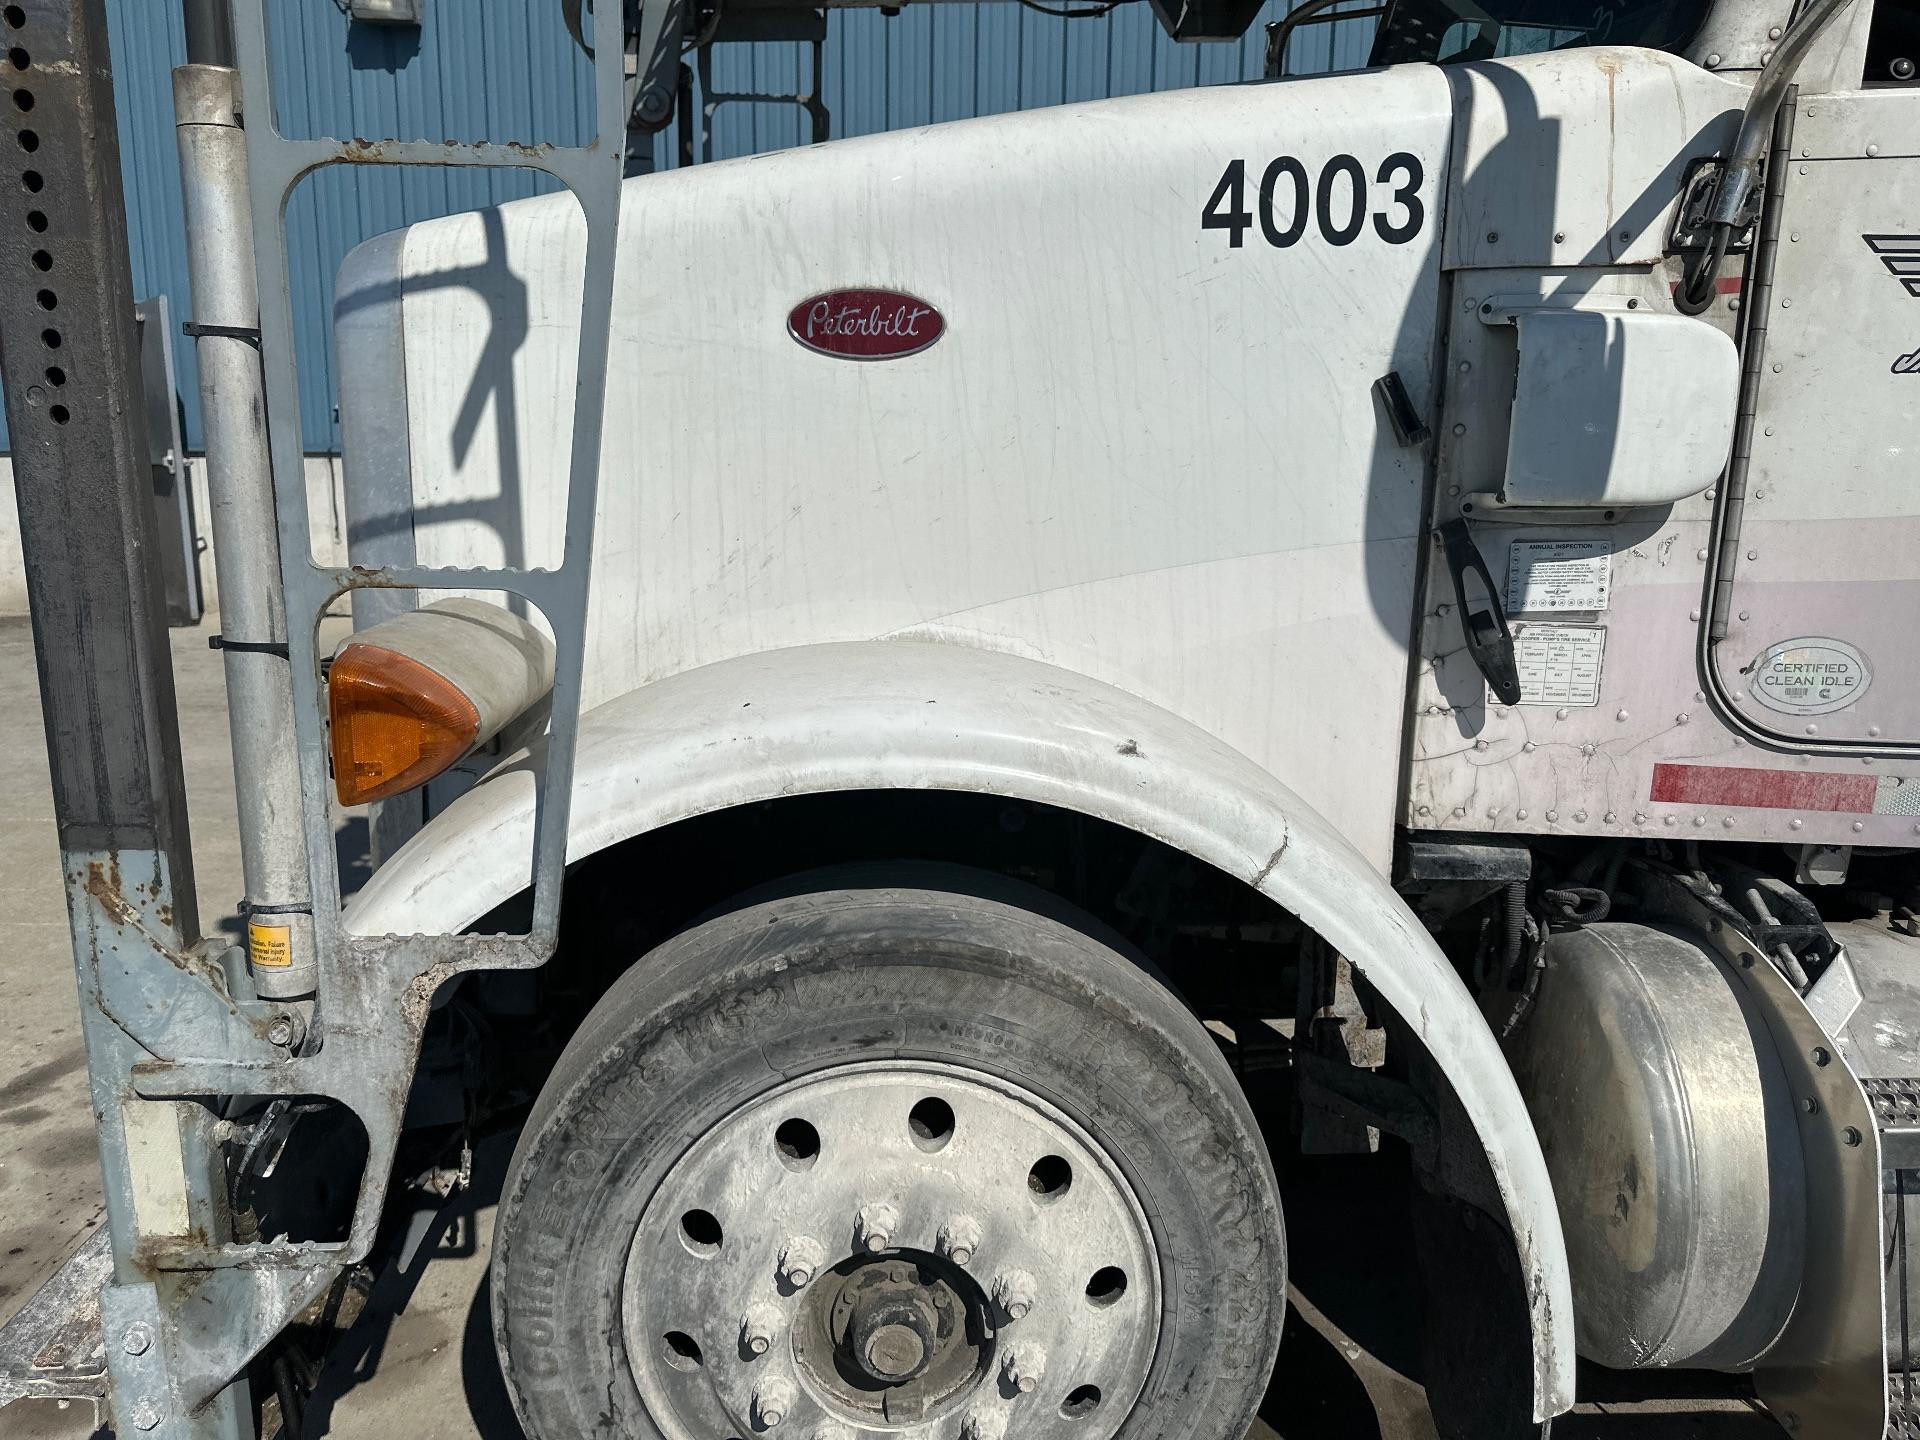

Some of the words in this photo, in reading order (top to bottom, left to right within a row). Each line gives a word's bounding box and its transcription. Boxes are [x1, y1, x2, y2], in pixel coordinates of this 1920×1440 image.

[1202, 151, 1425, 249] 4003
[807, 301, 931, 339] Peterbilt
[1773, 663, 1848, 673] CERTIFIED
[1764, 676, 1814, 686] CLEAN
[1821, 676, 1854, 686] IDLE
